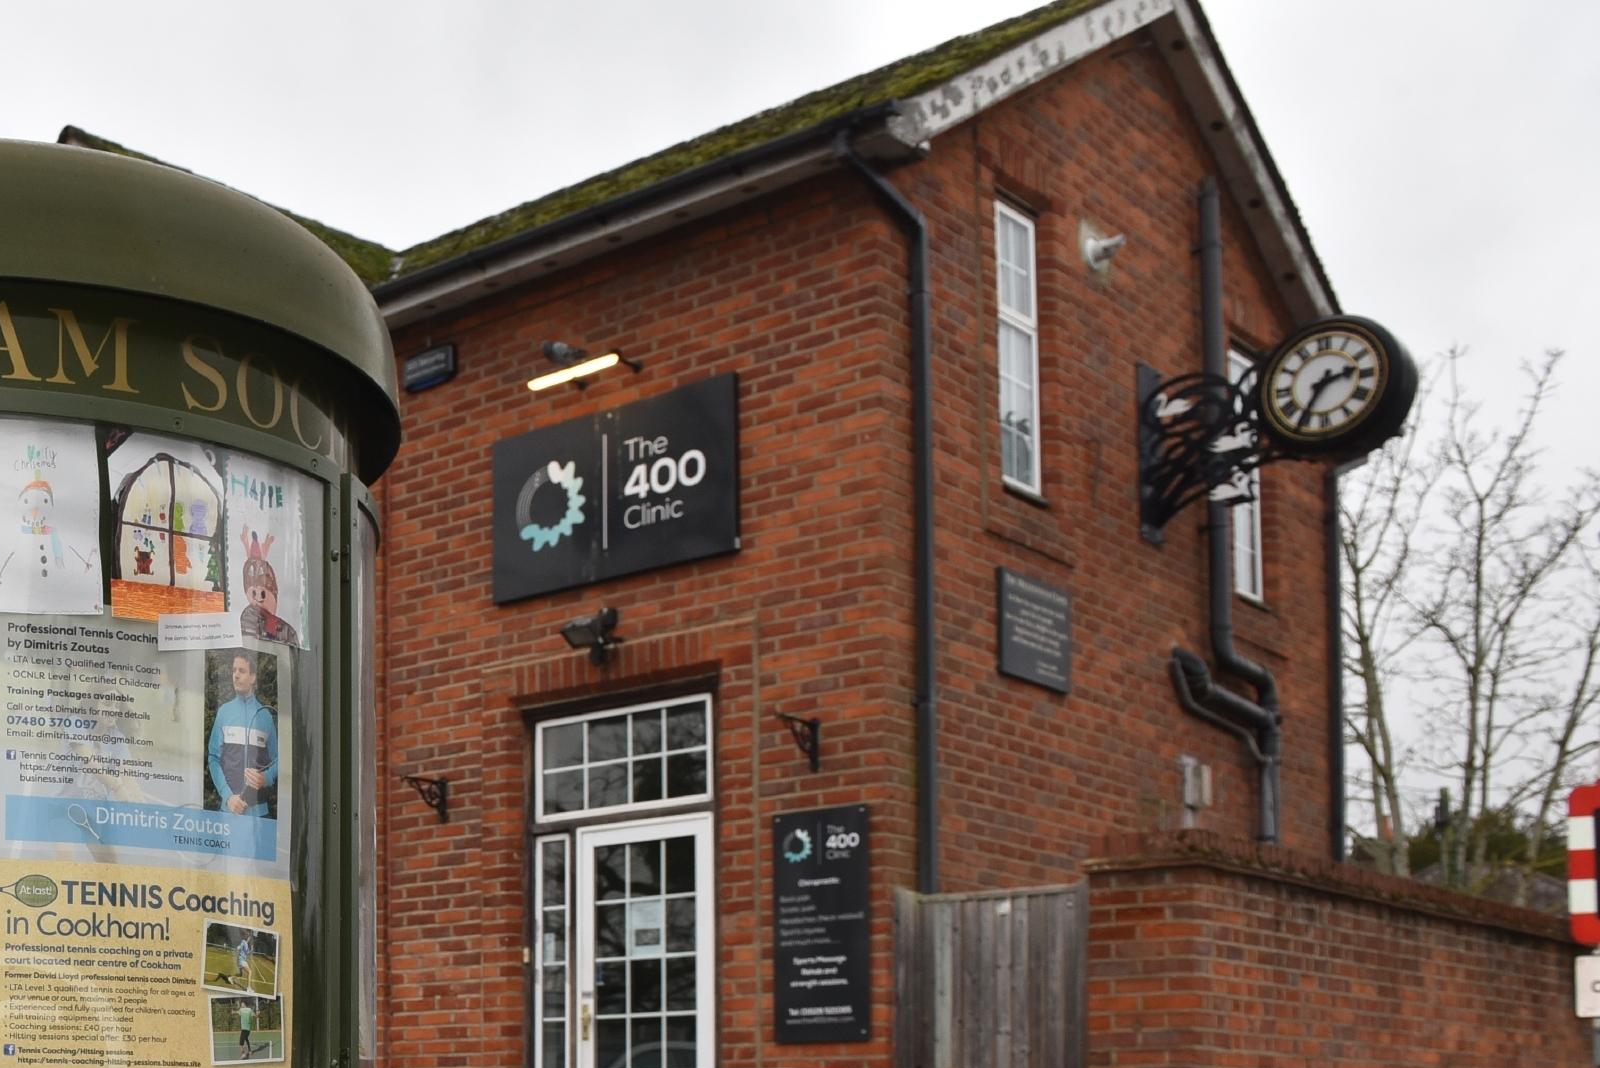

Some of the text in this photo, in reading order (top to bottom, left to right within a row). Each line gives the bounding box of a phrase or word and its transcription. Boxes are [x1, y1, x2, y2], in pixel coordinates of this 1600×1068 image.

[623, 435, 669, 462] The
[623, 449, 706, 499] 400
[623, 497, 684, 529] Clinic
[8, 622, 77, 635] Professional
[80, 627, 114, 639] Tennis
[116, 631, 157, 644] Coachin
[8, 637, 110, 654] by Dimitris Zoutas
[31, 657, 54, 665] Level
[55, 658, 62, 666] 3
[65, 658, 106, 669] Qualified
[108, 662, 134, 671] Tennis
[136, 665, 161, 674] Coach
[13, 670, 160, 689] OCNLR Level 1 Certified Childcarer
[7, 686, 134, 702] Training Packages available
[7, 702, 23, 710] Call
[56, 705, 87, 714] Dimitris
[89, 707, 100, 716] for
[102, 710, 124, 718] more
[124, 711, 150, 720] details
[7, 716, 97, 729] 07480 370 097
[20, 751, 47, 760] Tennis
[123, 759, 153, 767] sessions
[20, 774, 74, 784] business.site
[96, 807, 231, 835] Dimitris Zoutas
[175, 836, 230, 848] TENNIS COACH
[825, 832, 860, 849] 400
[20, 885, 32, 894] At
[63, 881, 275, 924] TENNIS Coaching
[7, 910, 170, 940] in Cookham!
[5, 943, 65, 952] Professional
[67, 945, 97, 954] tennis
[99, 947, 141, 958] coaching
[163, 950, 193, 959] private
[33, 957, 72, 965] located
[98, 960, 128, 968] centre
[130, 959, 139, 968] of
[141, 960, 181, 970] Cookham
[58, 973, 79, 981] Lloyd
[9, 1023, 47, 1032] Coaching
[84, 1024, 100, 1032] £40
[101, 1026, 114, 1034] per
